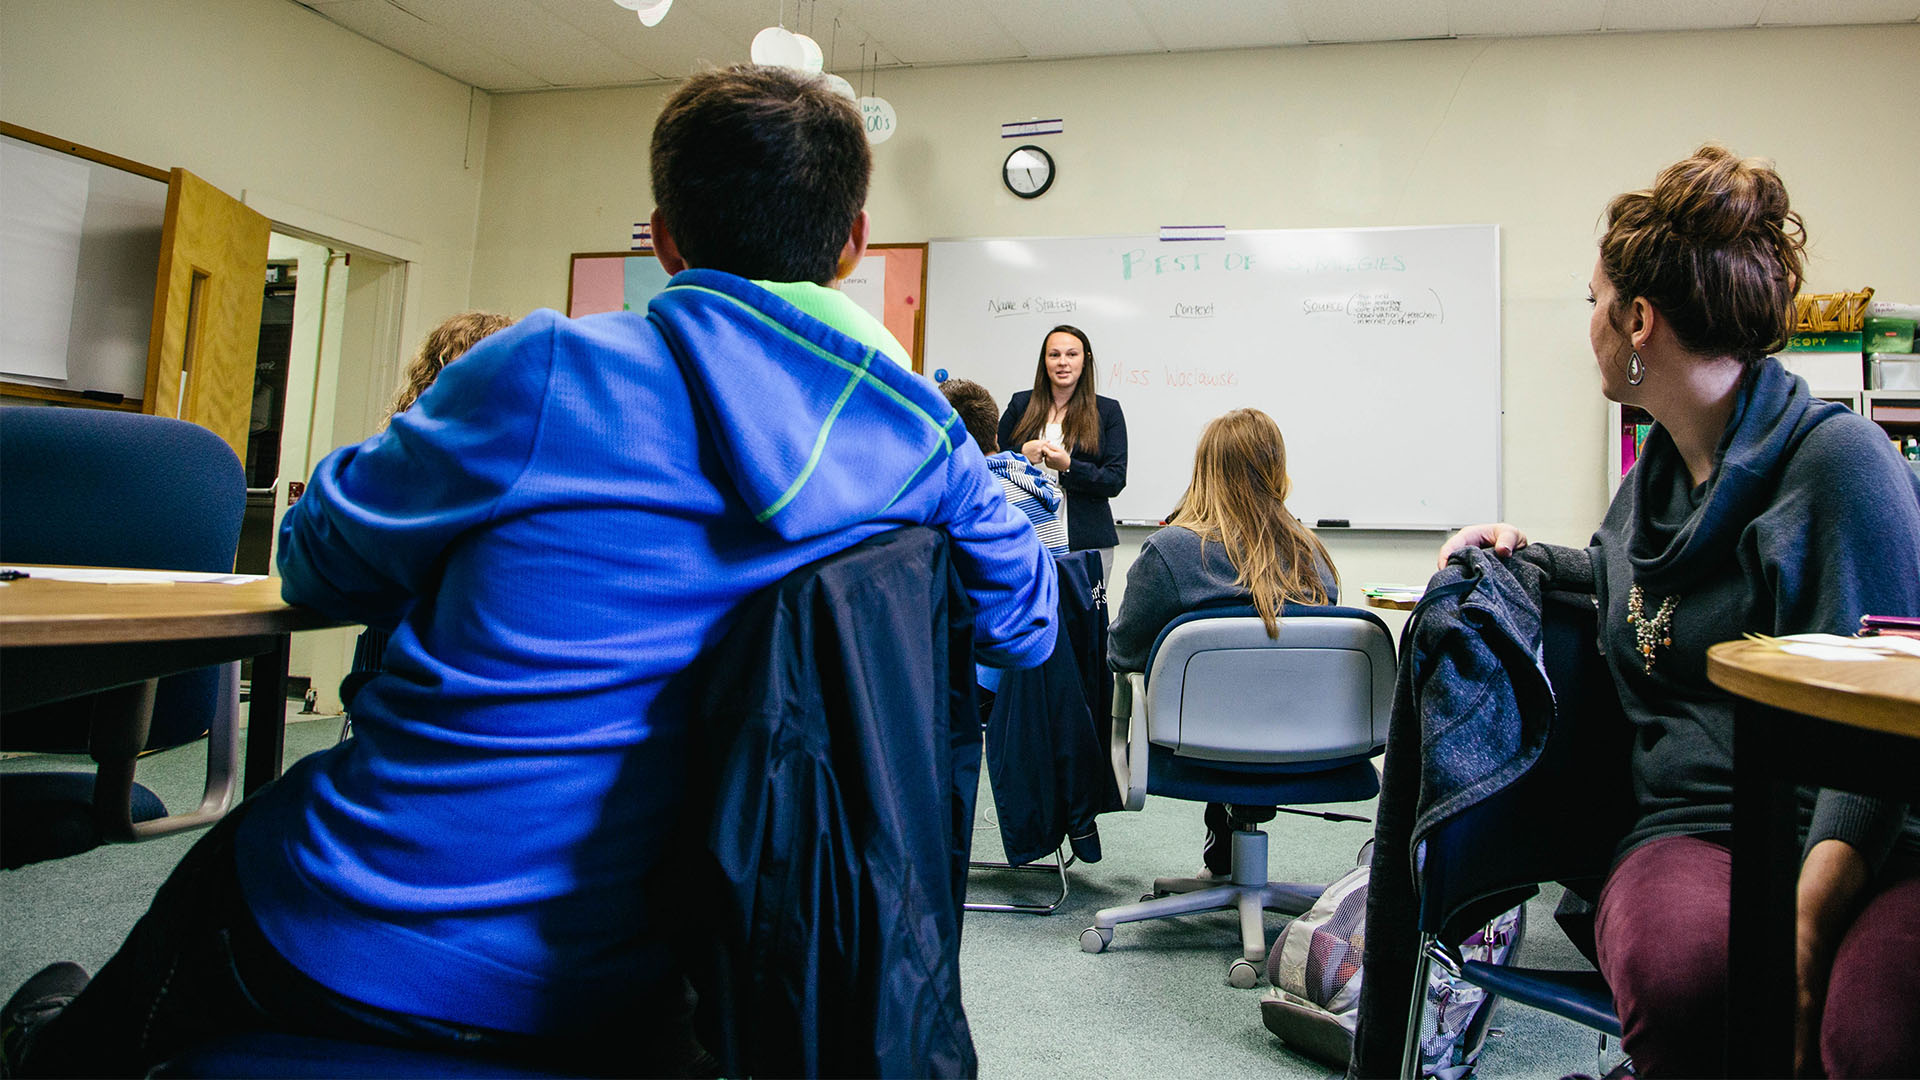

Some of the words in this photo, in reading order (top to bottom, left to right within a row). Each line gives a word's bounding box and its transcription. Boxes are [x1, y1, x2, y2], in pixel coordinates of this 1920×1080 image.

[1121, 249, 1209, 281] BEST
[1224, 252, 1257, 271] OF
[1287, 254, 1408, 272] SEGIES
[988, 297, 1016, 313] Name
[1022, 297, 1031, 310] of
[1034, 297, 1077, 313] Strategy
[1174, 302, 1214, 316] Context
[1109, 360, 1151, 388] Miss
